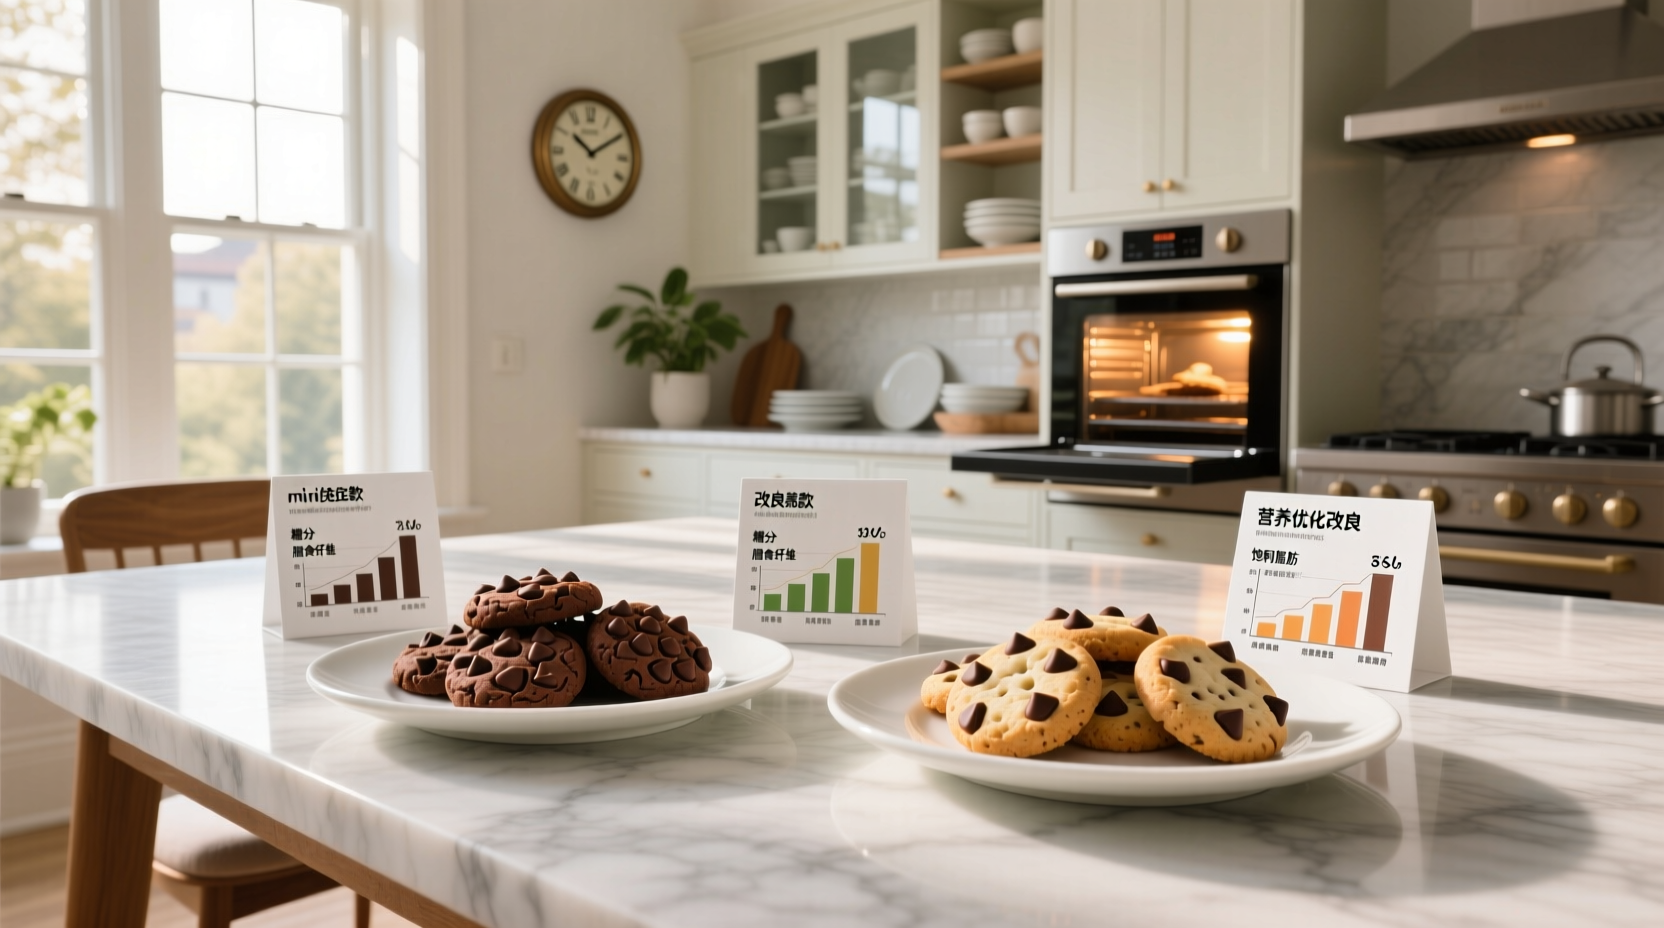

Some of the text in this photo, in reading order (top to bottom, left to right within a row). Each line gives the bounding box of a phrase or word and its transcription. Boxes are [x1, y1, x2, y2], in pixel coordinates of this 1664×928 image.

[1258, 507, 1361, 532] 营养优化改良
